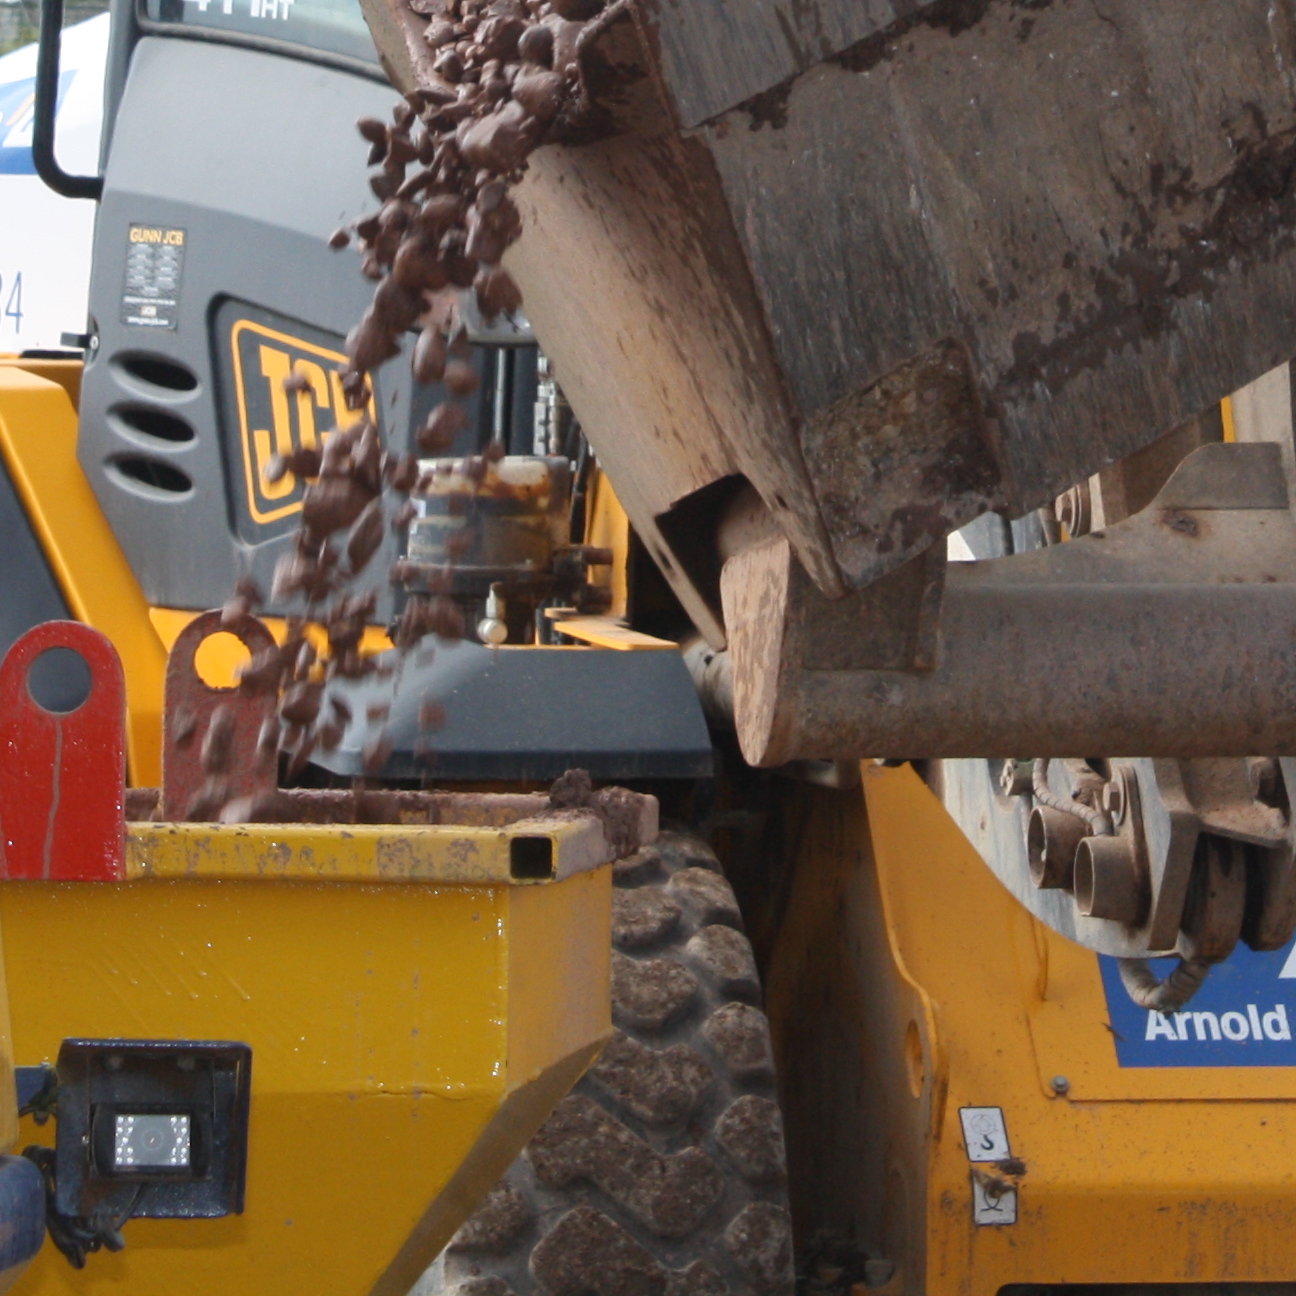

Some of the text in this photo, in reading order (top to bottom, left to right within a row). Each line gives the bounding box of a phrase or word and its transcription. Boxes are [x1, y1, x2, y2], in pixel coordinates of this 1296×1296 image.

[129, 227, 184, 245] GUNN JCB
[1144, 1003, 1292, 1041] Arnold
